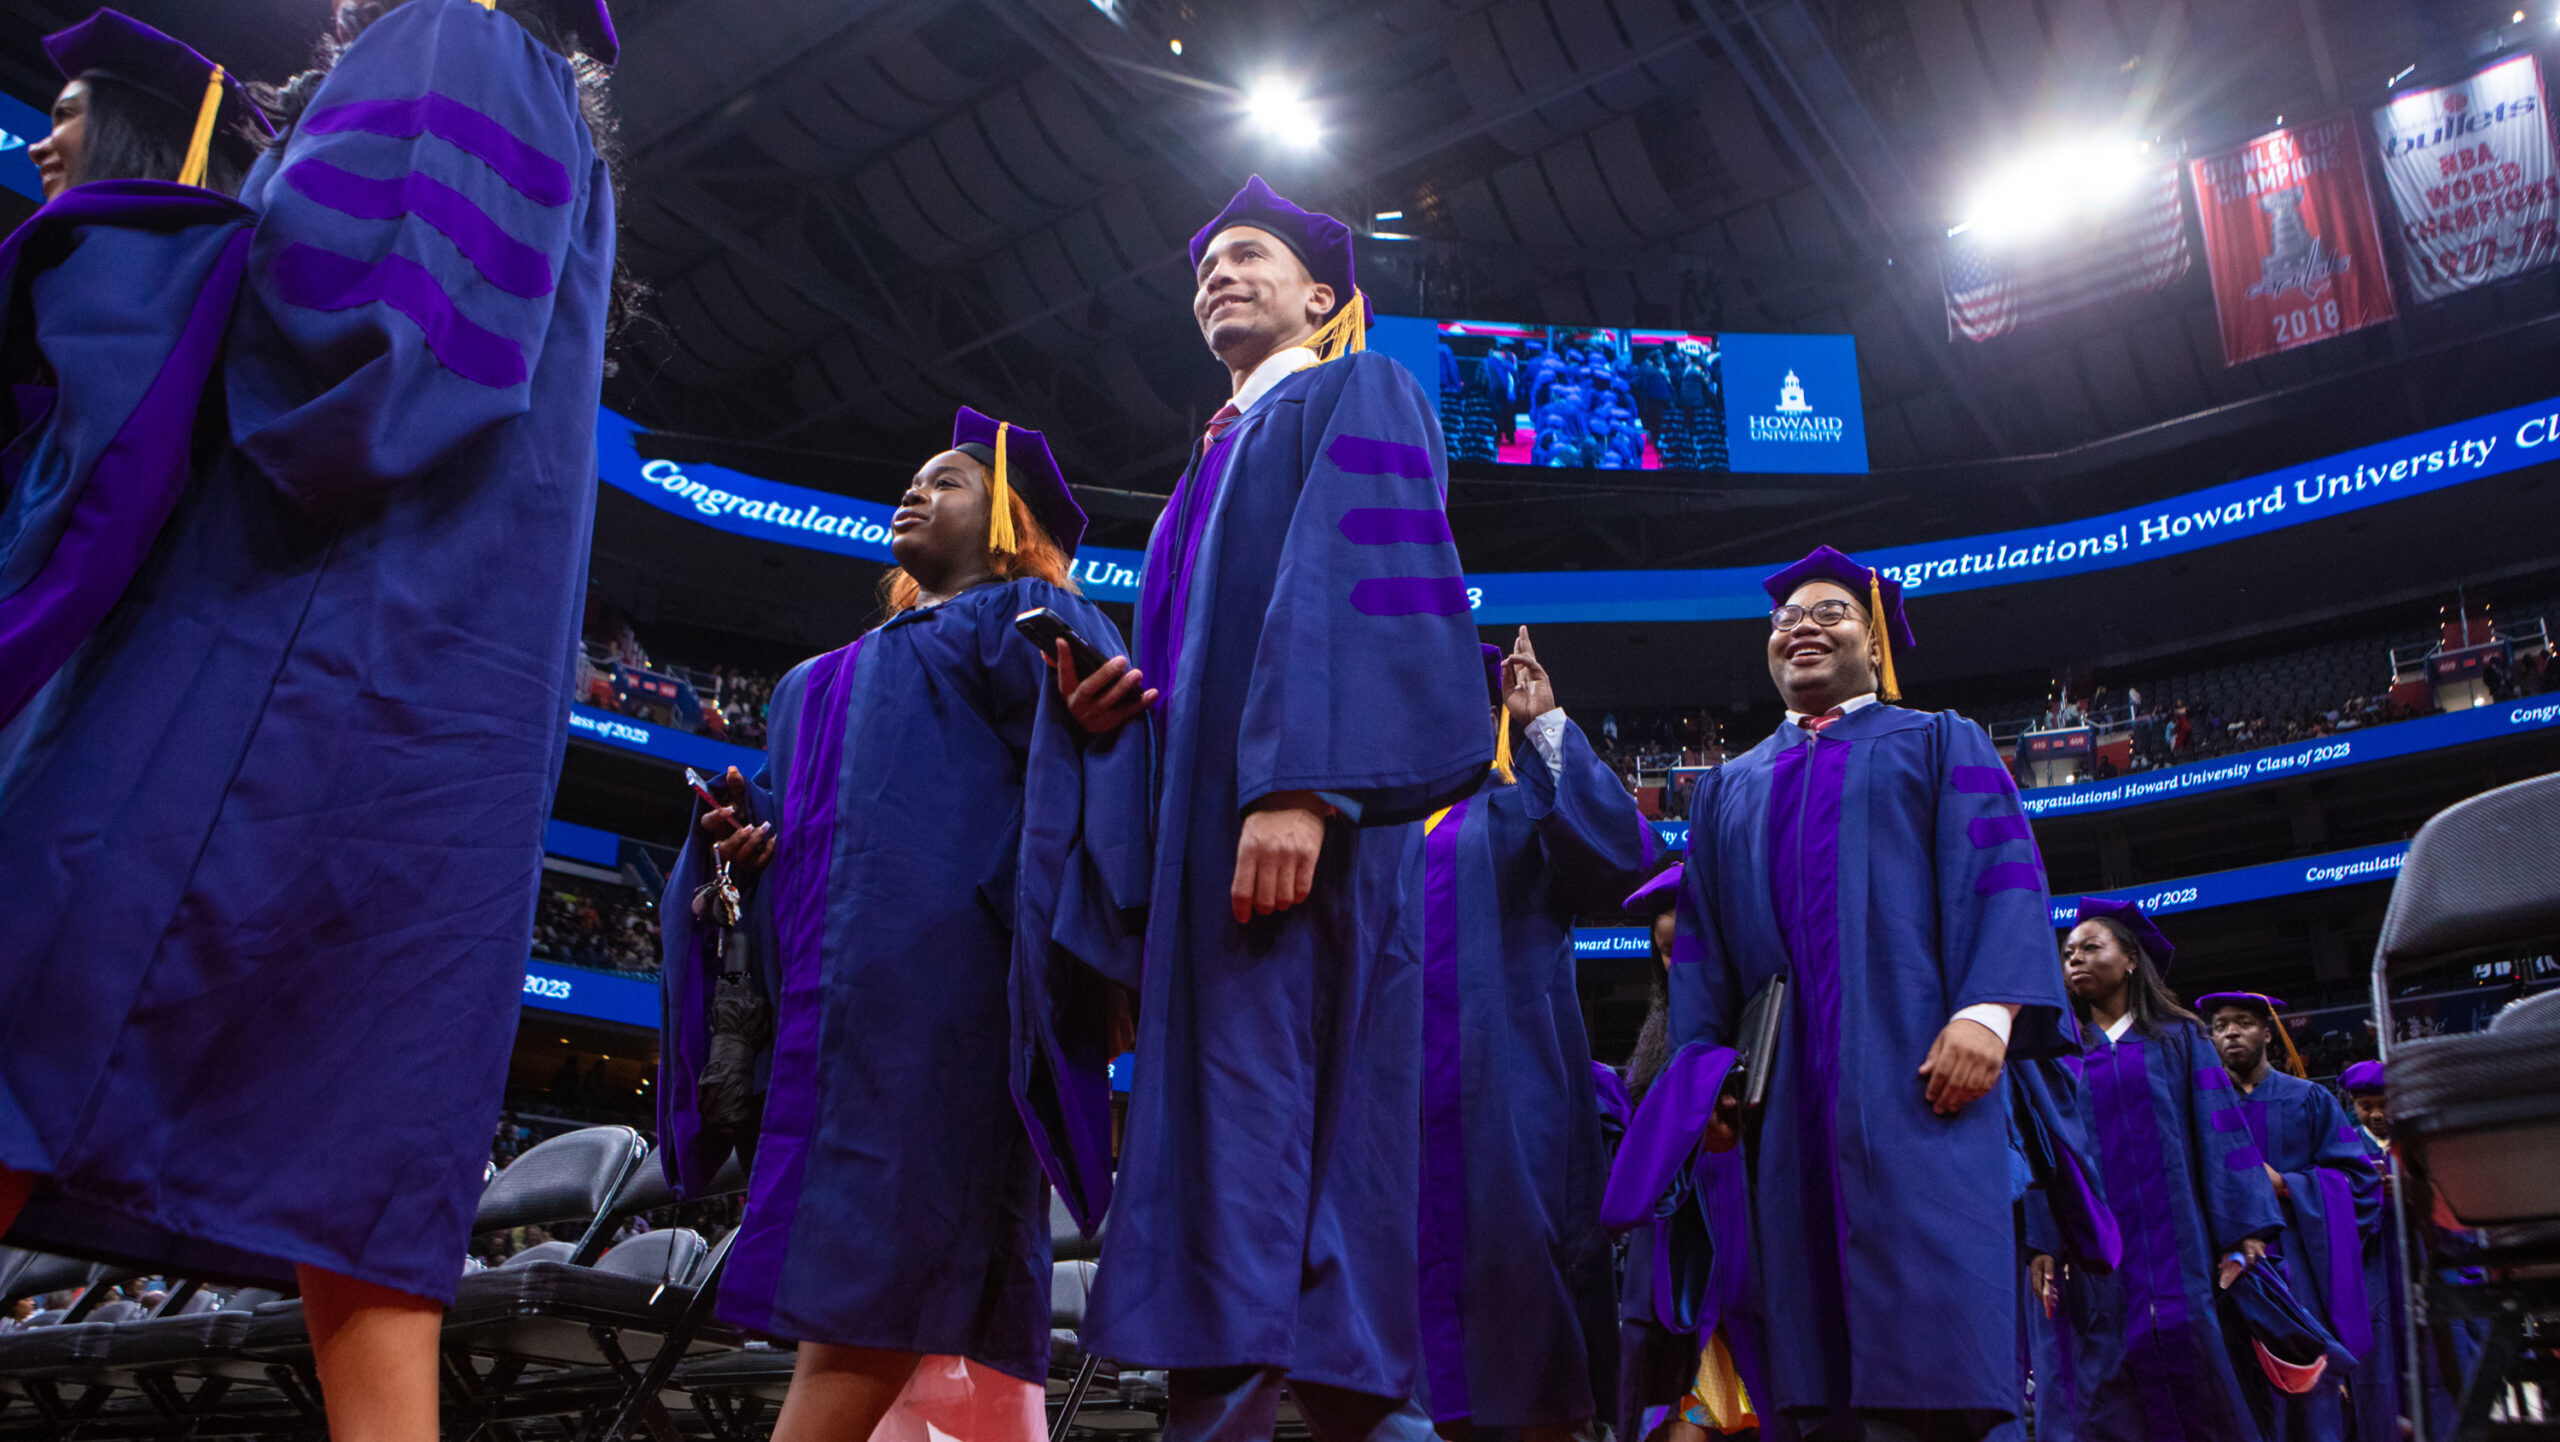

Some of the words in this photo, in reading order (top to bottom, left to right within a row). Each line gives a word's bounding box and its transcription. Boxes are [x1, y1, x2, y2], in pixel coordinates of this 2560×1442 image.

[2387, 96, 2536, 160] bullets
[2203, 134, 2295, 187] STANLEY
[2303, 121, 2345, 152] CUP
[2439, 142, 2494, 177] NBA
[2216, 150, 2342, 205] CHAMPIONS
[2426, 161, 2521, 210] WORLD
[2403, 175, 2560, 245] CHAMPIONS
[2272, 300, 2340, 344] 2018
[1749, 415, 1843, 431] HOWARD
[1750, 430, 1842, 442] UNIVERSITY
[2139, 485, 2286, 546] Howard
[2294, 435, 2497, 504] University
[596, 720, 613, 738] of
[611, 722, 650, 744] 2023
[2510, 703, 2560, 724] Congr
[2124, 775, 2179, 799] Howard
[2181, 763, 2252, 787] University
[2256, 756, 2295, 774] Class
[2297, 749, 2313, 768] of
[2313, 742, 2350, 764] 2023
[2146, 893, 2162, 911] of
[2162, 887, 2198, 907] 2023
[522, 974, 572, 999] 2023
